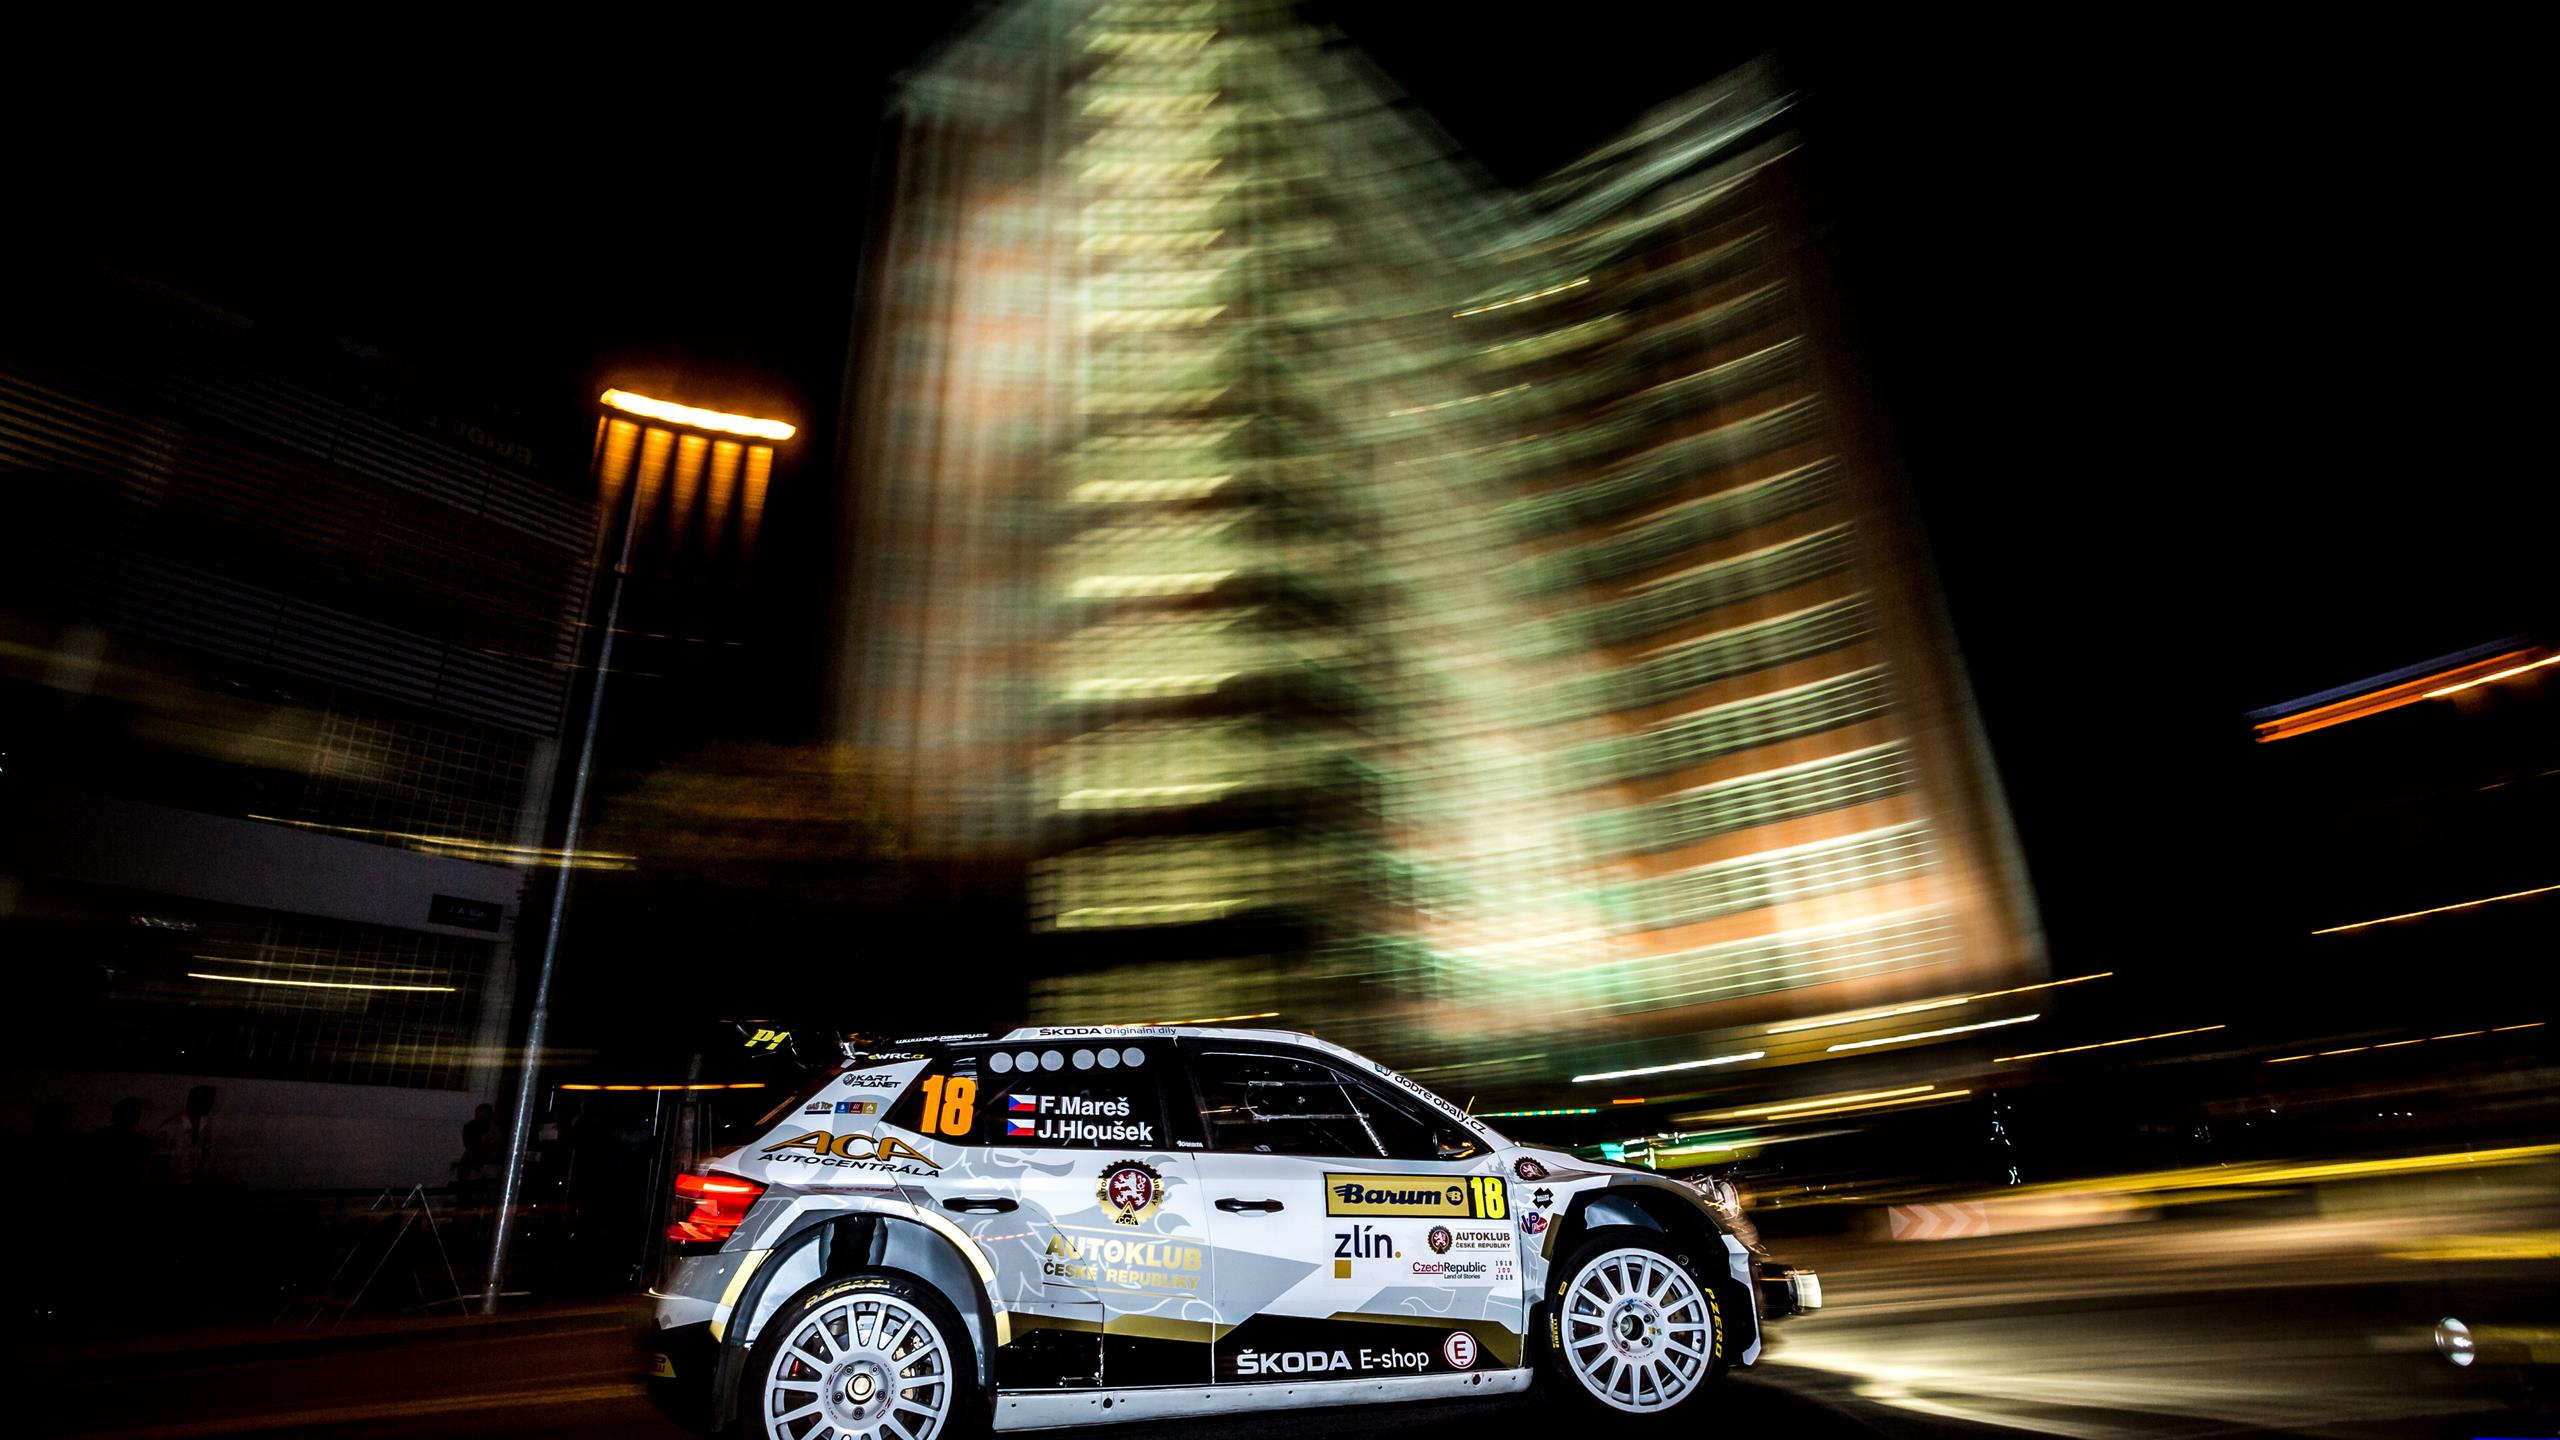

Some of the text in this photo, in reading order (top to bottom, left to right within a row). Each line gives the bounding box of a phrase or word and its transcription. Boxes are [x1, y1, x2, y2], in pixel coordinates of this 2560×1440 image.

[1039, 1028, 1102, 1036] ŠKODA
[921, 1074, 977, 1136] 18
[1038, 1096, 1130, 1116] F.Mareš
[1395, 1074, 1486, 1135] dobre obaly.cz
[1037, 1119, 1153, 1142] J.Hloušek
[760, 1130, 944, 1170] ACA
[758, 1153, 940, 1178] AUTOCENTRÁLA
[1333, 1183, 1441, 1206] Barum
[1470, 1177, 1505, 1219] 18
[1521, 1211, 1539, 1235] VP
[1456, 1232, 1510, 1241] AUTOKLUB
[1045, 1234, 1201, 1270] AUTOKLUB
[1043, 1259, 1200, 1290] ČESKÉ REPUBLIKY
[1236, 1348, 1429, 1375] ŠKODA E-shop
[1453, 1340, 1468, 1360] E
